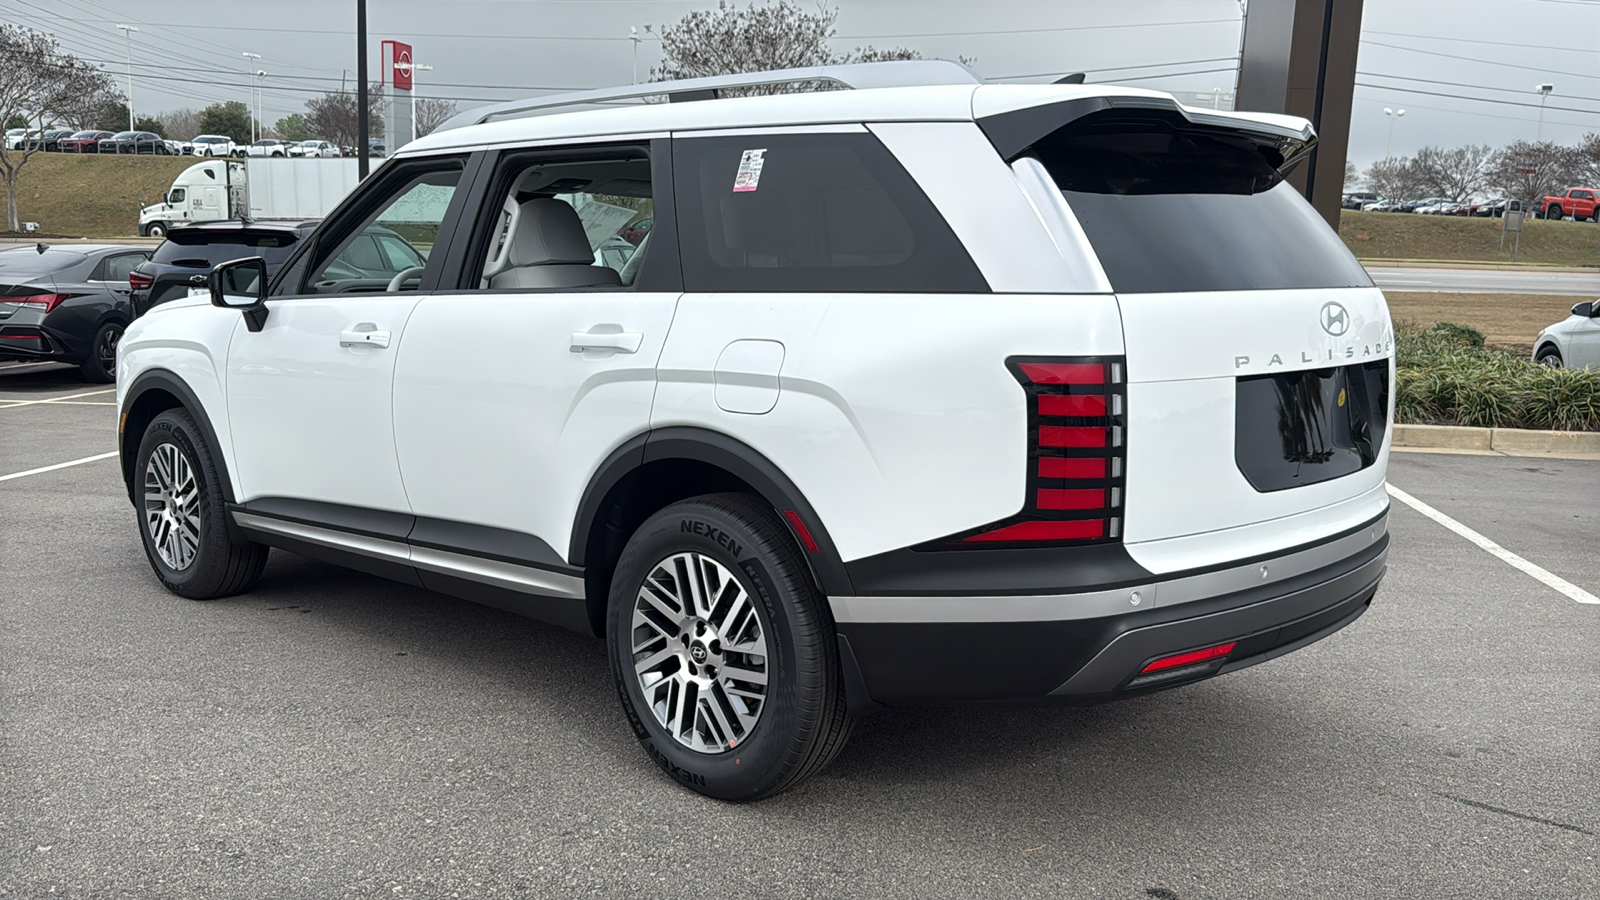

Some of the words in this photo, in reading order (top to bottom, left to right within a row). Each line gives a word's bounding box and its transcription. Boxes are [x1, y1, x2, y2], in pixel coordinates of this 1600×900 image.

[1235, 341, 1390, 368] PALISADE
[681, 520, 742, 557] NEXEN
[648, 742, 707, 787] NEXEN
